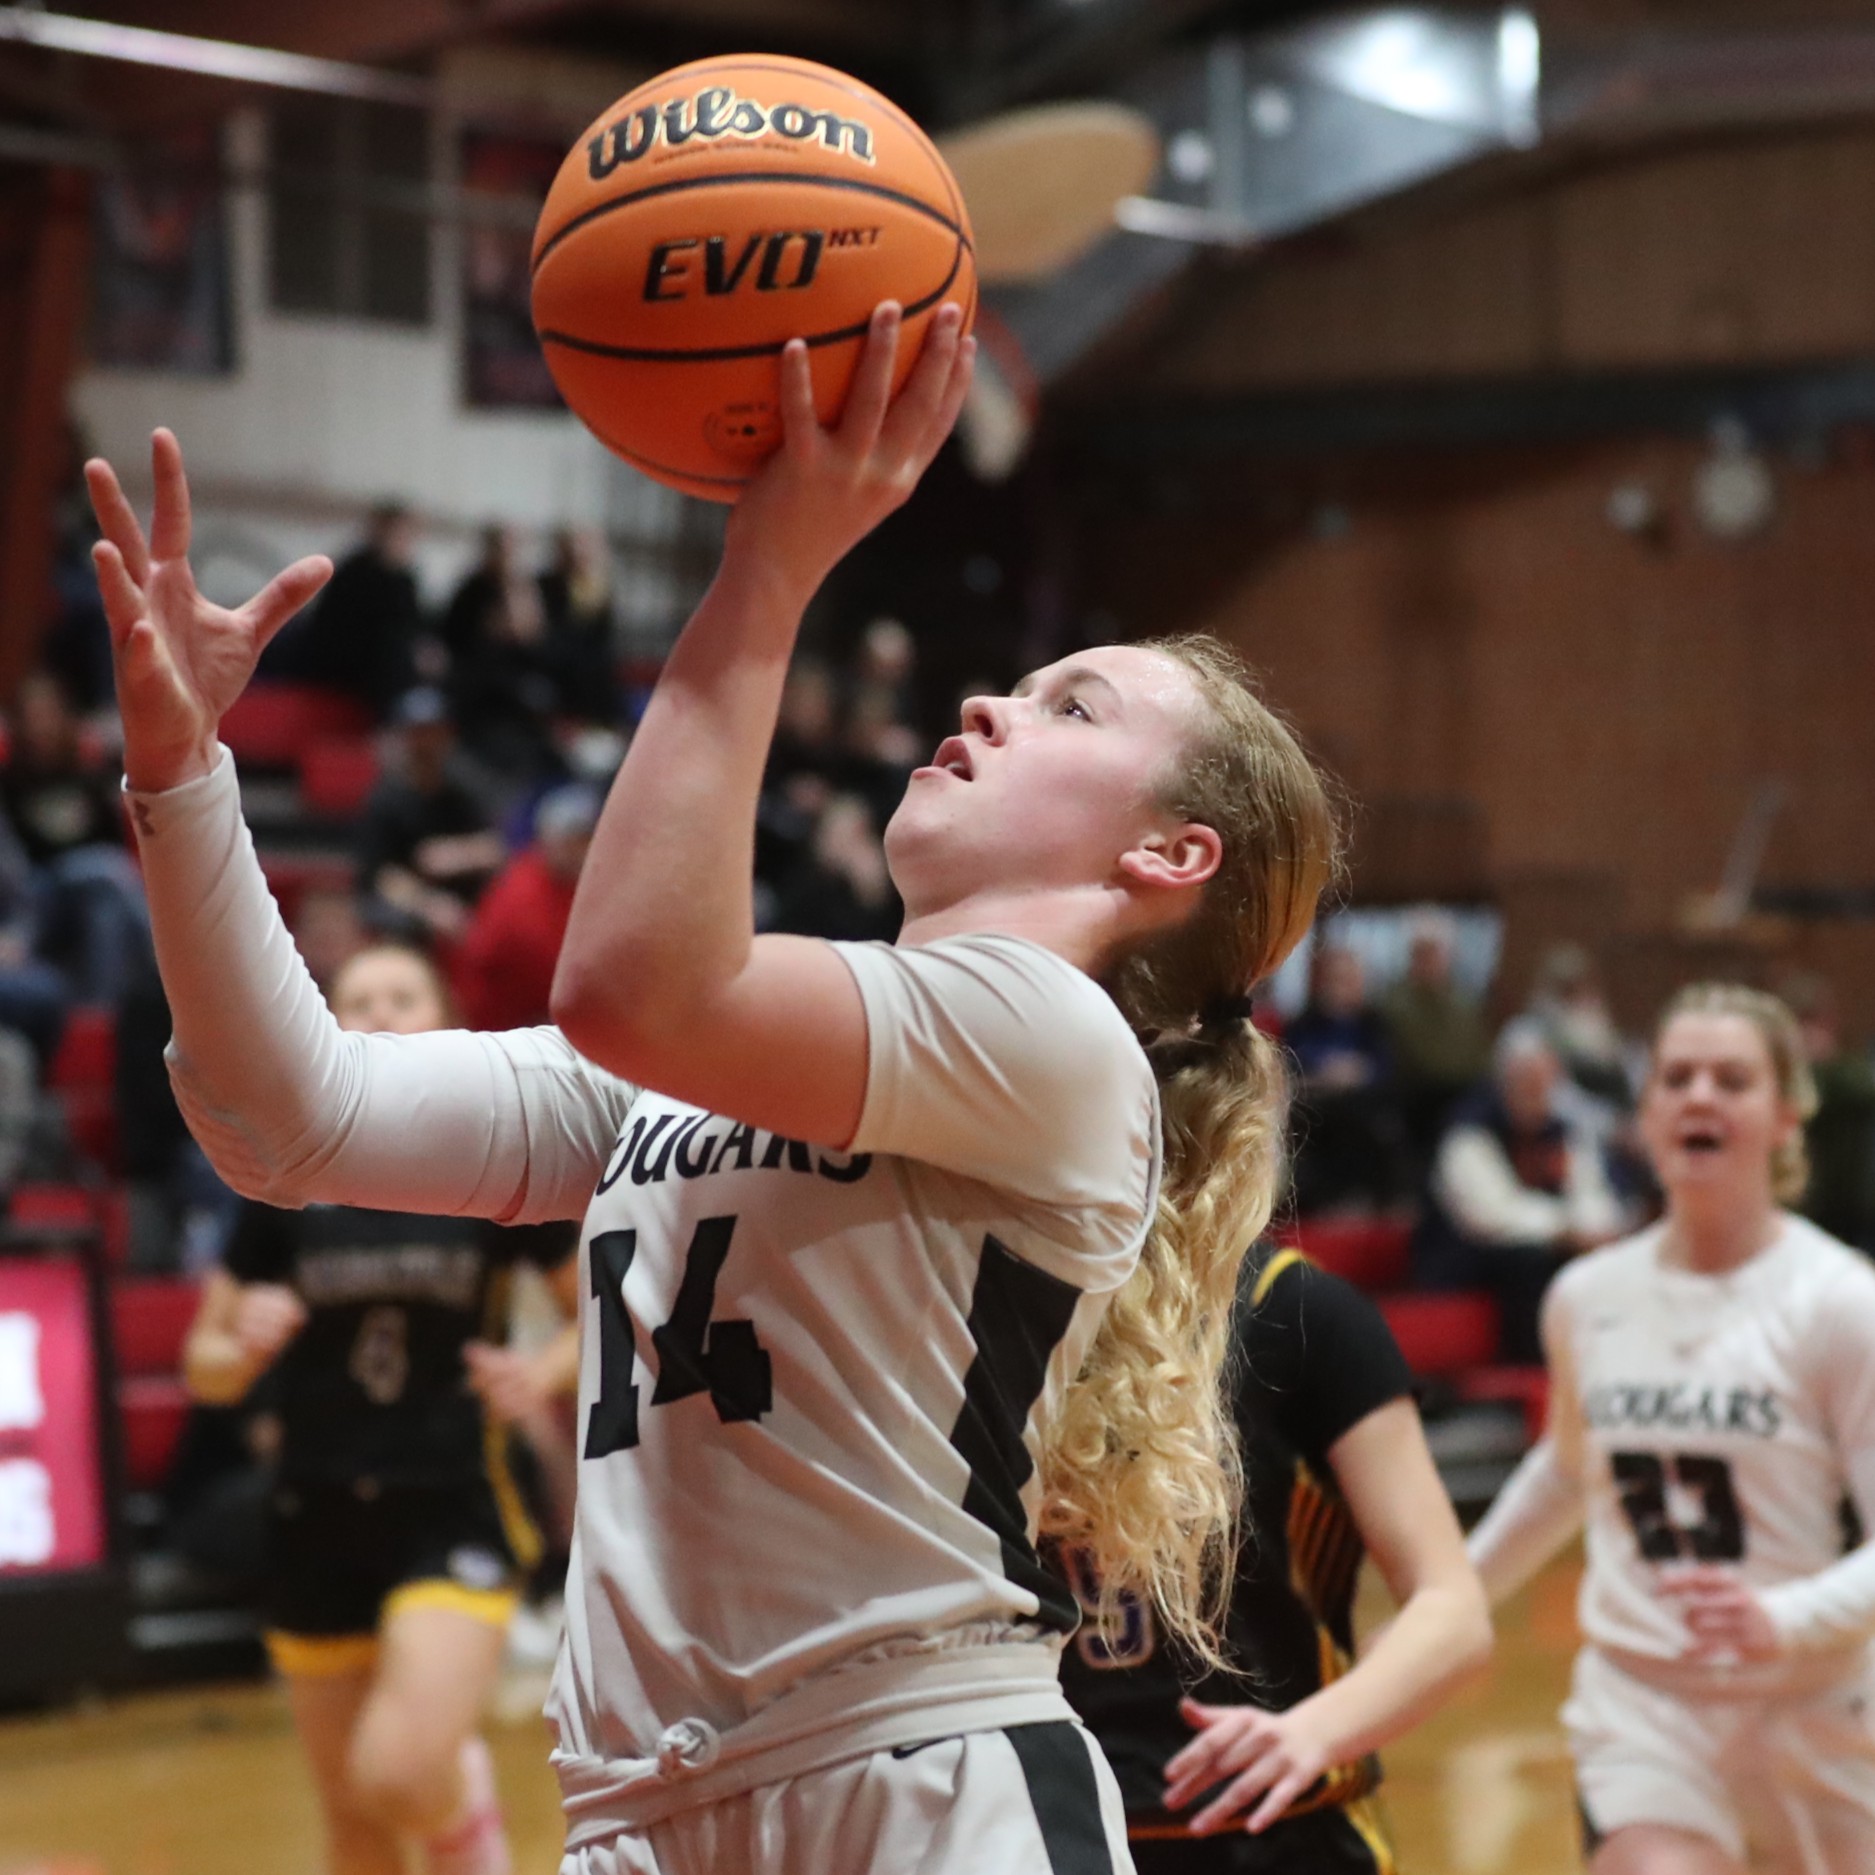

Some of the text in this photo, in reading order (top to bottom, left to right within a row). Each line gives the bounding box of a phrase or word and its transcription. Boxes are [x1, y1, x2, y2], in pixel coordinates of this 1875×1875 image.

[587, 86, 876, 181] Wilson
[642, 227, 881, 304] EVO NXT
[584, 1214, 773, 1460] 14
